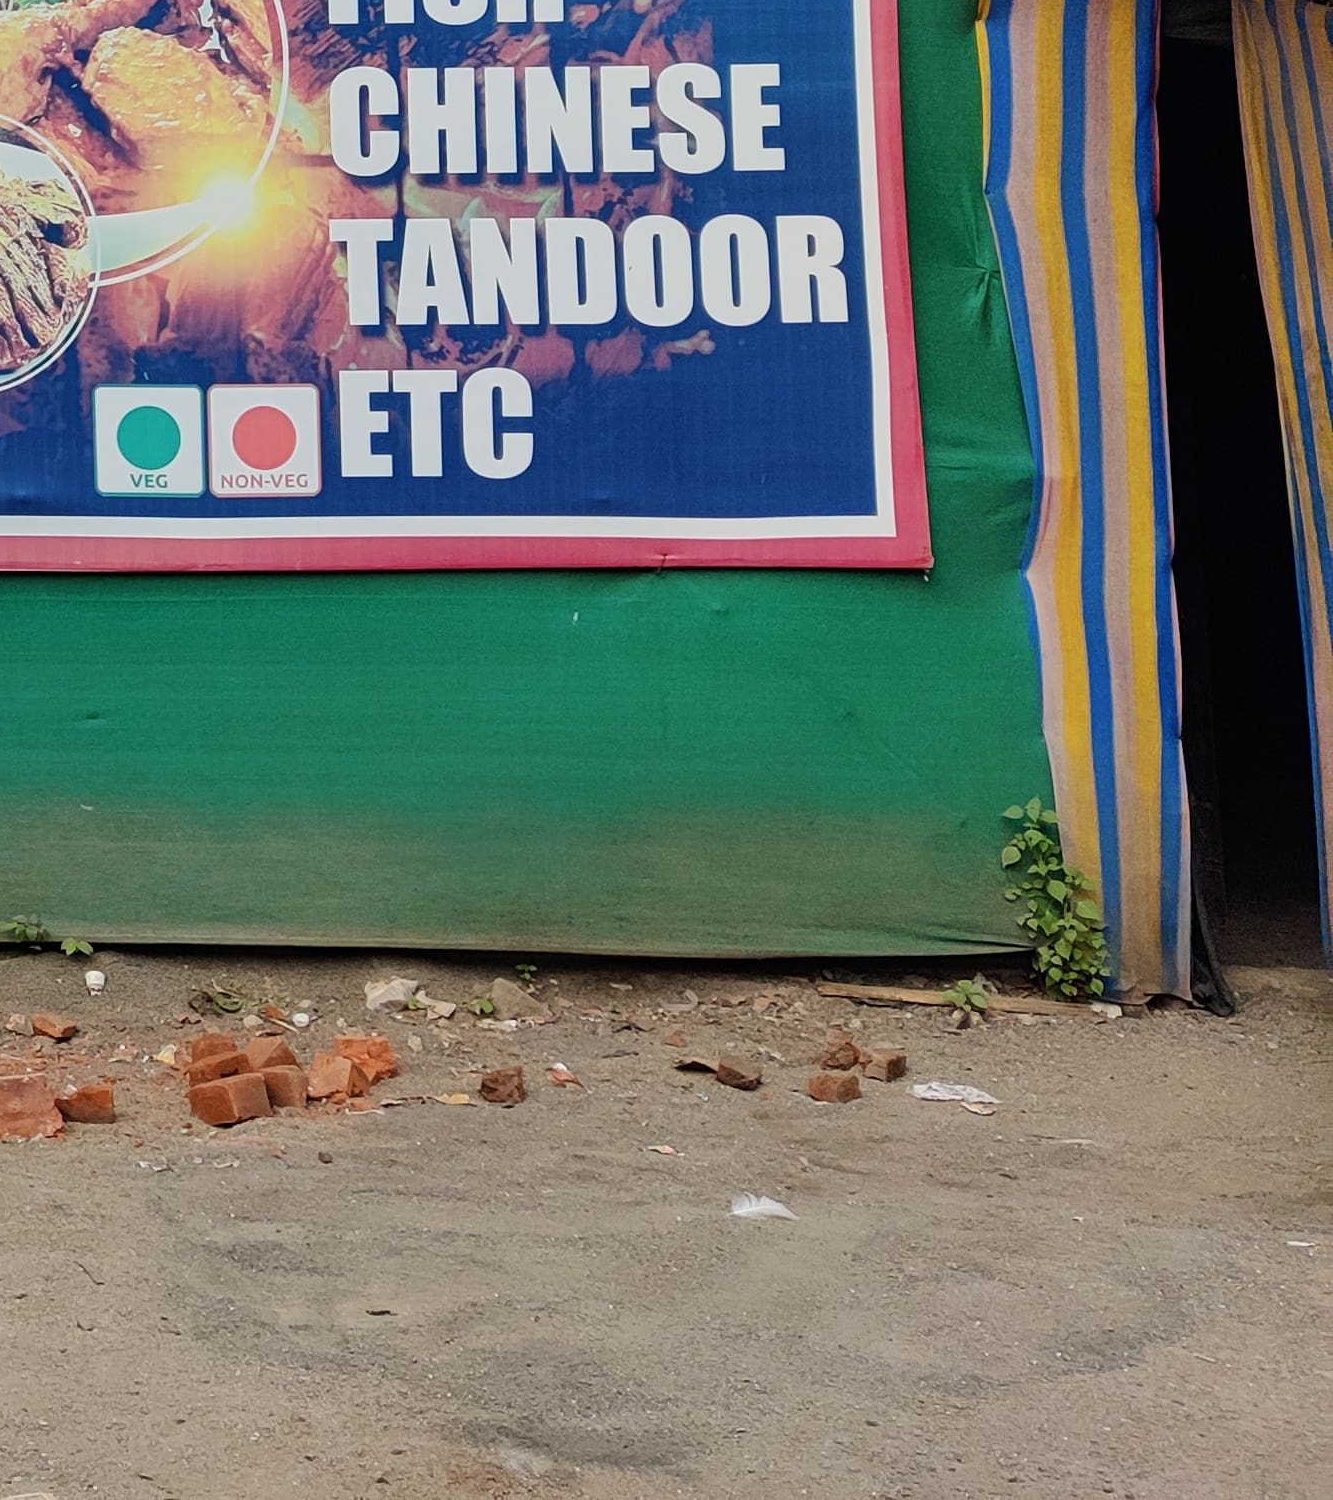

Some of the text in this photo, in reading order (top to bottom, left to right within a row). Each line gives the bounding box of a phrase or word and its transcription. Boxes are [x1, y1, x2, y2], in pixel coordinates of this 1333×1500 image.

[329, 63, 787, 178] CHINESE
[330, 214, 850, 329] TANDOOR
[130, 473, 169, 489] VEG
[220, 473, 309, 489] NON-VEG
[338, 366, 535, 481] ETC
